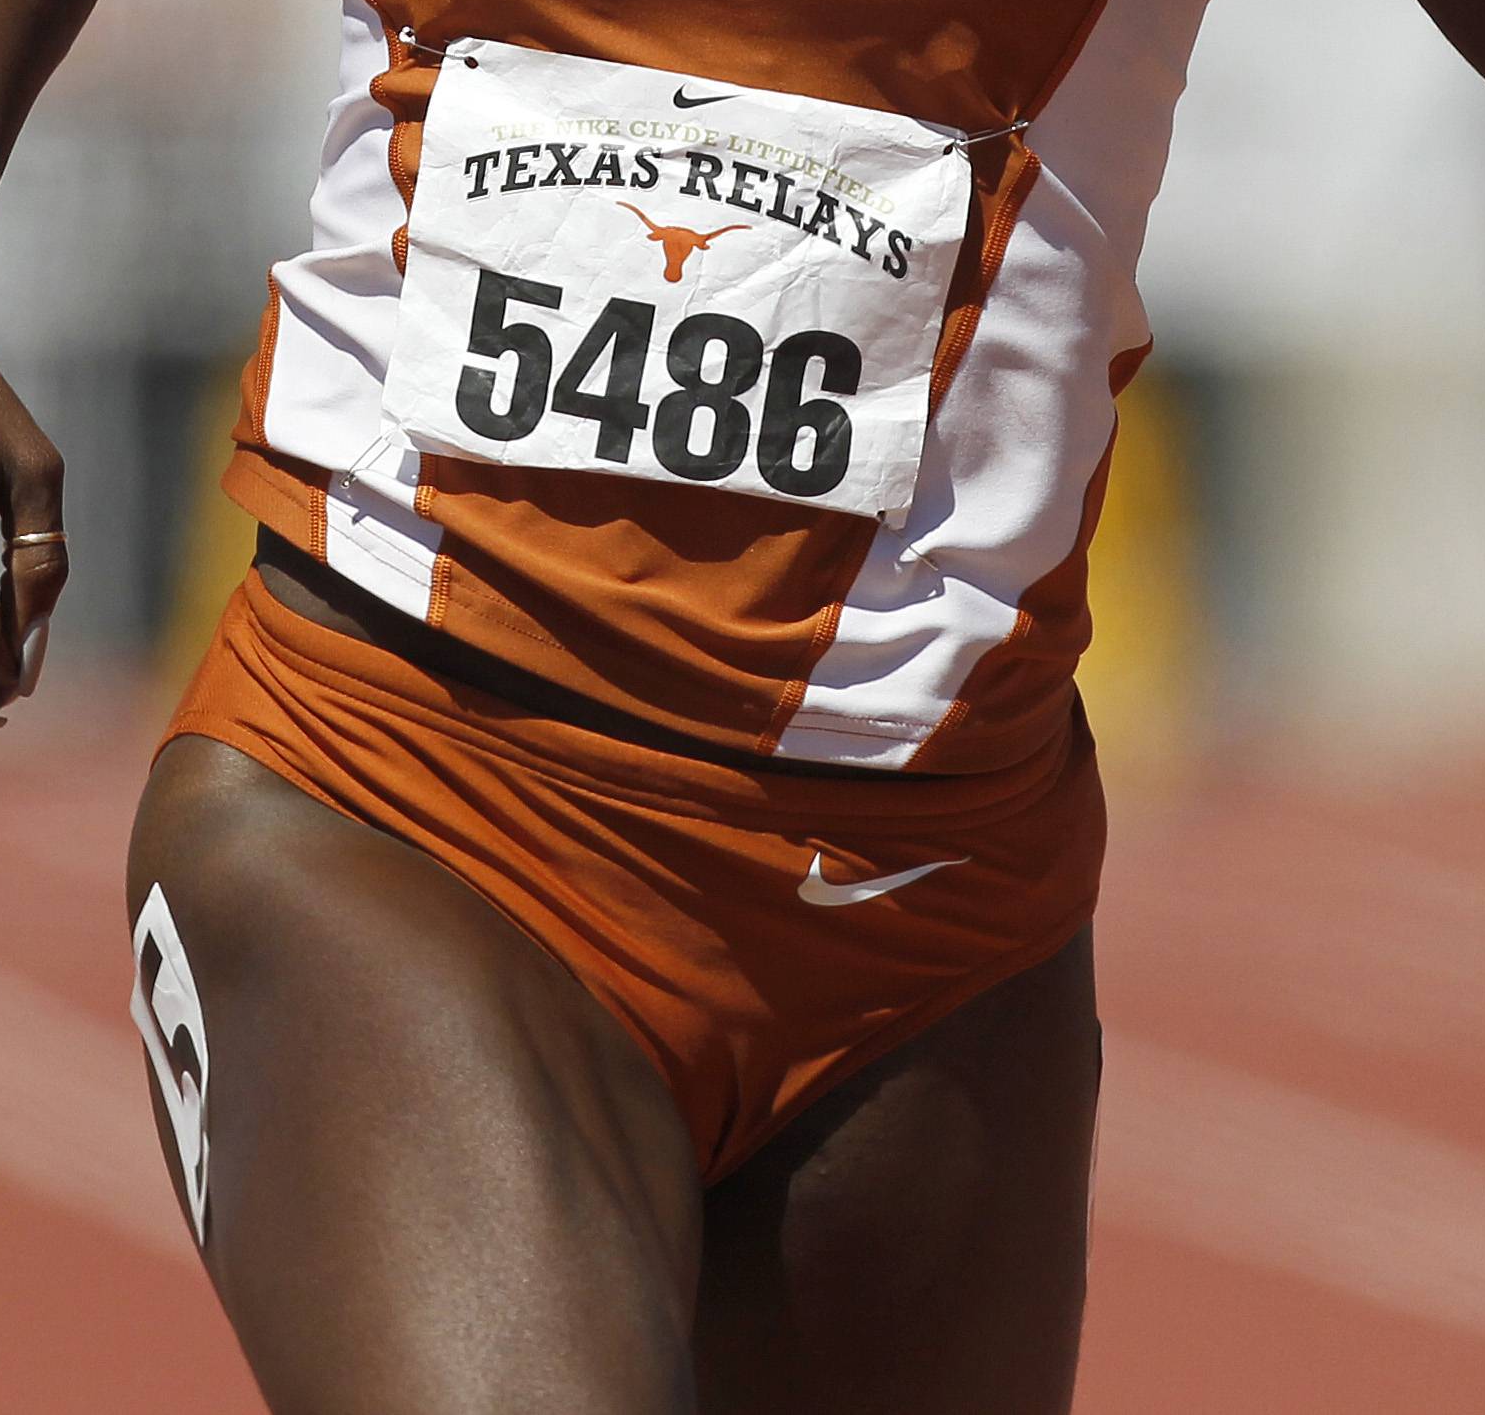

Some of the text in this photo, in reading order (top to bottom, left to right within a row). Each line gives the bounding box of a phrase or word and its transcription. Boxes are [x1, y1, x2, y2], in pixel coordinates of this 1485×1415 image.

[556, 119, 620, 136] NIKE
[629, 120, 719, 147] CLYDE
[464, 142, 913, 279] TEXAS RELAYS
[455, 269, 863, 498] 5486
